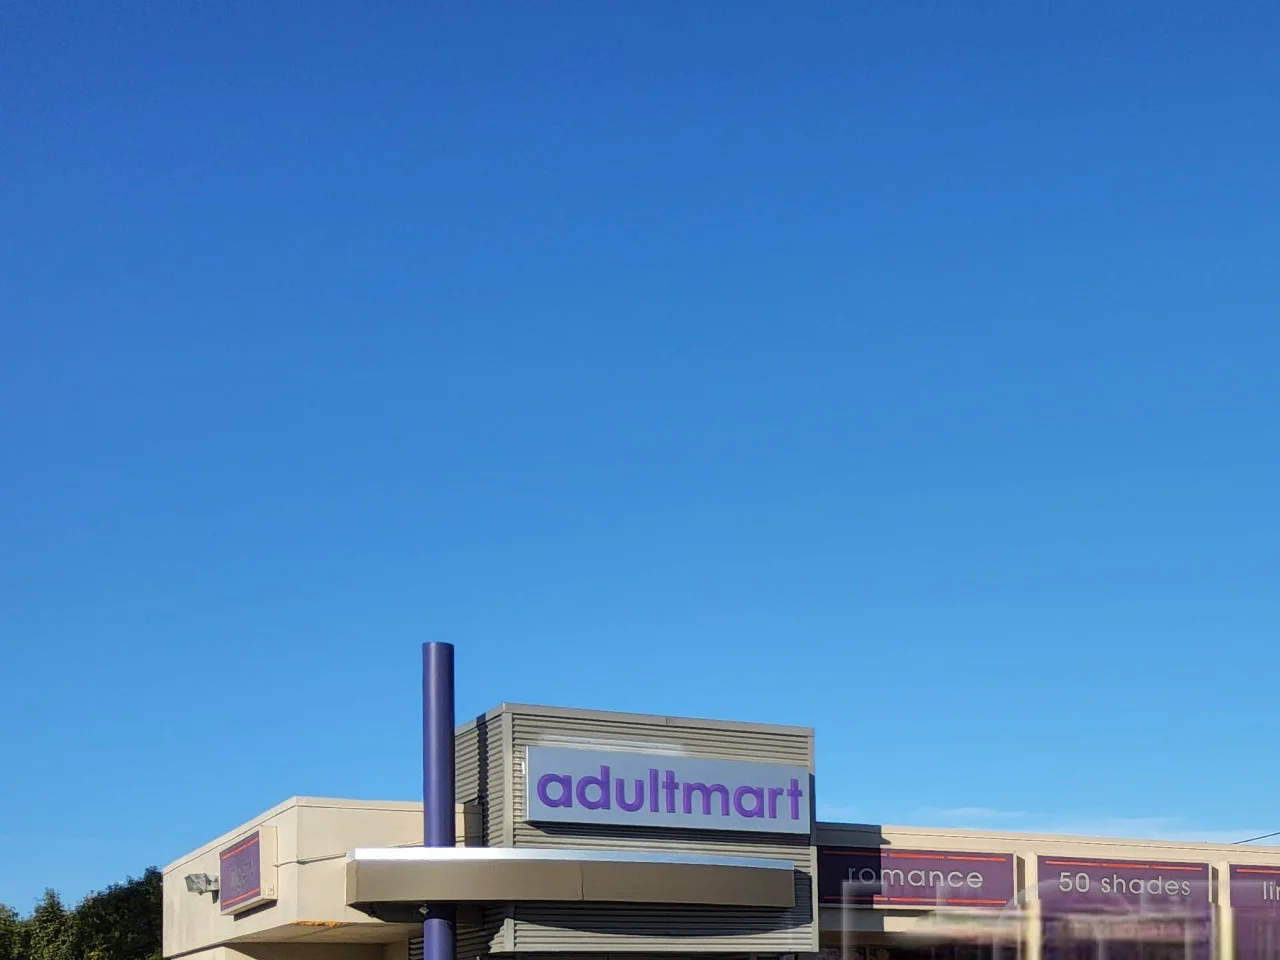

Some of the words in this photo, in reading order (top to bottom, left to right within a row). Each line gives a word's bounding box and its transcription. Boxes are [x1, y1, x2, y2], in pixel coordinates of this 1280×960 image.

[536, 764, 803, 820] adultmart
[848, 867, 983, 888] romance
[1059, 872, 1090, 893] 50
[1101, 874, 1191, 896] shades
